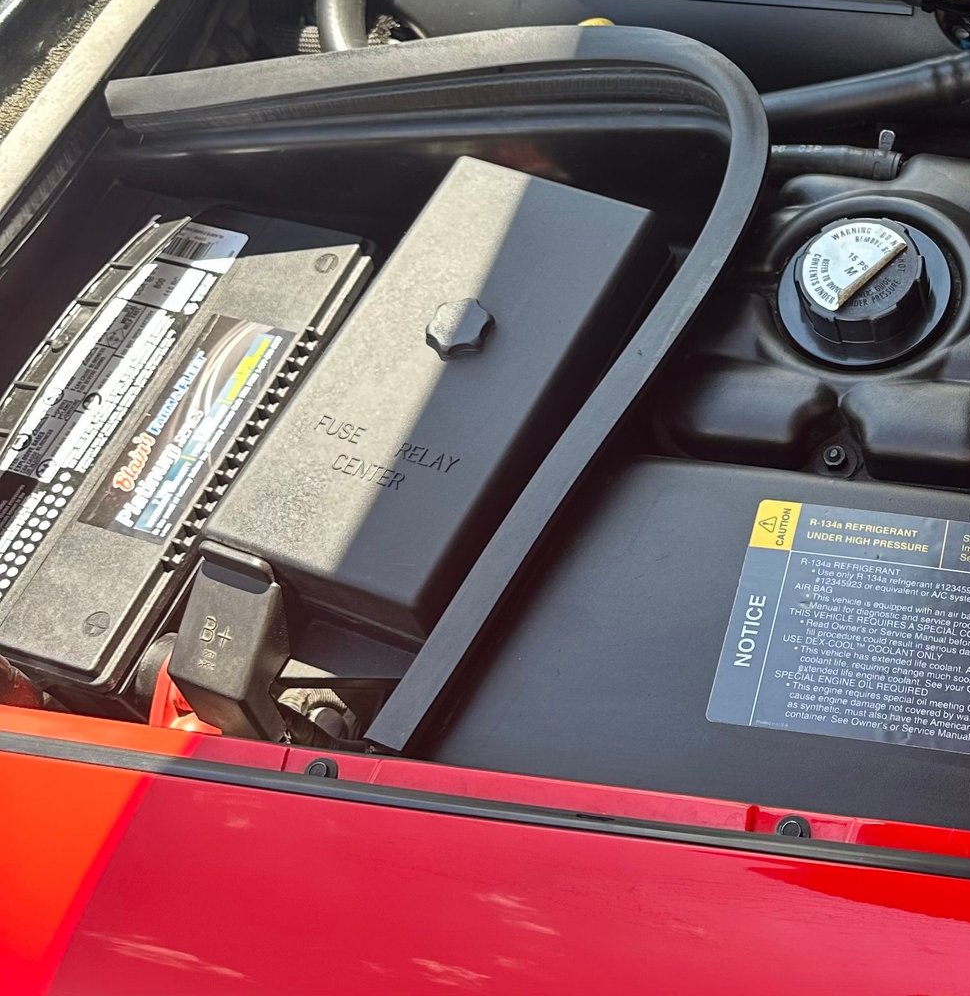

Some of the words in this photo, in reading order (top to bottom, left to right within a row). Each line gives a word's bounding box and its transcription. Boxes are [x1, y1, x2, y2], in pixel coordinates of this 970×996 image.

[831, 227, 872, 241] WARNING
[855, 235, 881, 248] REMOVE
[809, 253, 822, 287] CONTENTS
[844, 266, 858, 276] M
[848, 252, 859, 262] 15
[857, 260, 869, 271] PS
[897, 258, 906, 273] HOT
[814, 287, 835, 304] UNDER
[872, 280, 901, 303] PRESSURE
[314, 415, 368, 444] FUSE
[395, 442, 461, 473] RELAY
[113, 432, 155, 492] Blain's
[331, 454, 406, 490] CENTER
[115, 442, 182, 528] Platinum
[775, 507, 792, 546] CAUTION
[809, 518, 843, 530] R-134a
[844, 522, 918, 539] REFRIGERANT
[806, 531, 843, 544] UNDER
[844, 536, 871, 547] HIGH
[872, 539, 929, 554] PRESSURE
[800, 557, 832, 568] R-134a
[833, 561, 901, 577] REFRIGERANT
[816, 567, 835, 577] Use
[836, 570, 855, 581] only
[856, 572, 888, 583] R-134a
[889, 576, 933, 591] refrigerant
[794, 581, 812, 591] AIR
[812, 584, 834, 594] BAG
[874, 583, 919, 597] equivalent
[920, 590, 930, 598] or
[930, 590, 948, 600] A/C
[734, 594, 766, 668] NOTICE
[788, 607, 811, 617] THIS
[813, 610, 854, 623] VEHICLE
[856, 615, 907, 631] REQUIRES
[907, 622, 916, 631] A
[916, 623, 957, 636] SPECIAL
[782, 634, 803, 644] USE
[867, 644, 914, 658] COOLANT
[916, 650, 943, 661] ONLY
[774, 669, 816, 683] SPECIAL
[817, 675, 856, 688] ENGINE
[857, 680, 874, 690] OIL
[875, 682, 929, 699] REQUIRED
[791, 680, 811, 691] This
[812, 683, 843, 697] engine
[844, 687, 882, 702] requires
[883, 692, 915, 706] special
[916, 697, 927, 706] oil
[928, 698, 965, 713] meeting
[830, 715, 849, 726] See
[850, 717, 888, 731] Owner's
[889, 724, 899, 732] or
[901, 724, 936, 737] Service
[937, 728, 970, 742] Manual
